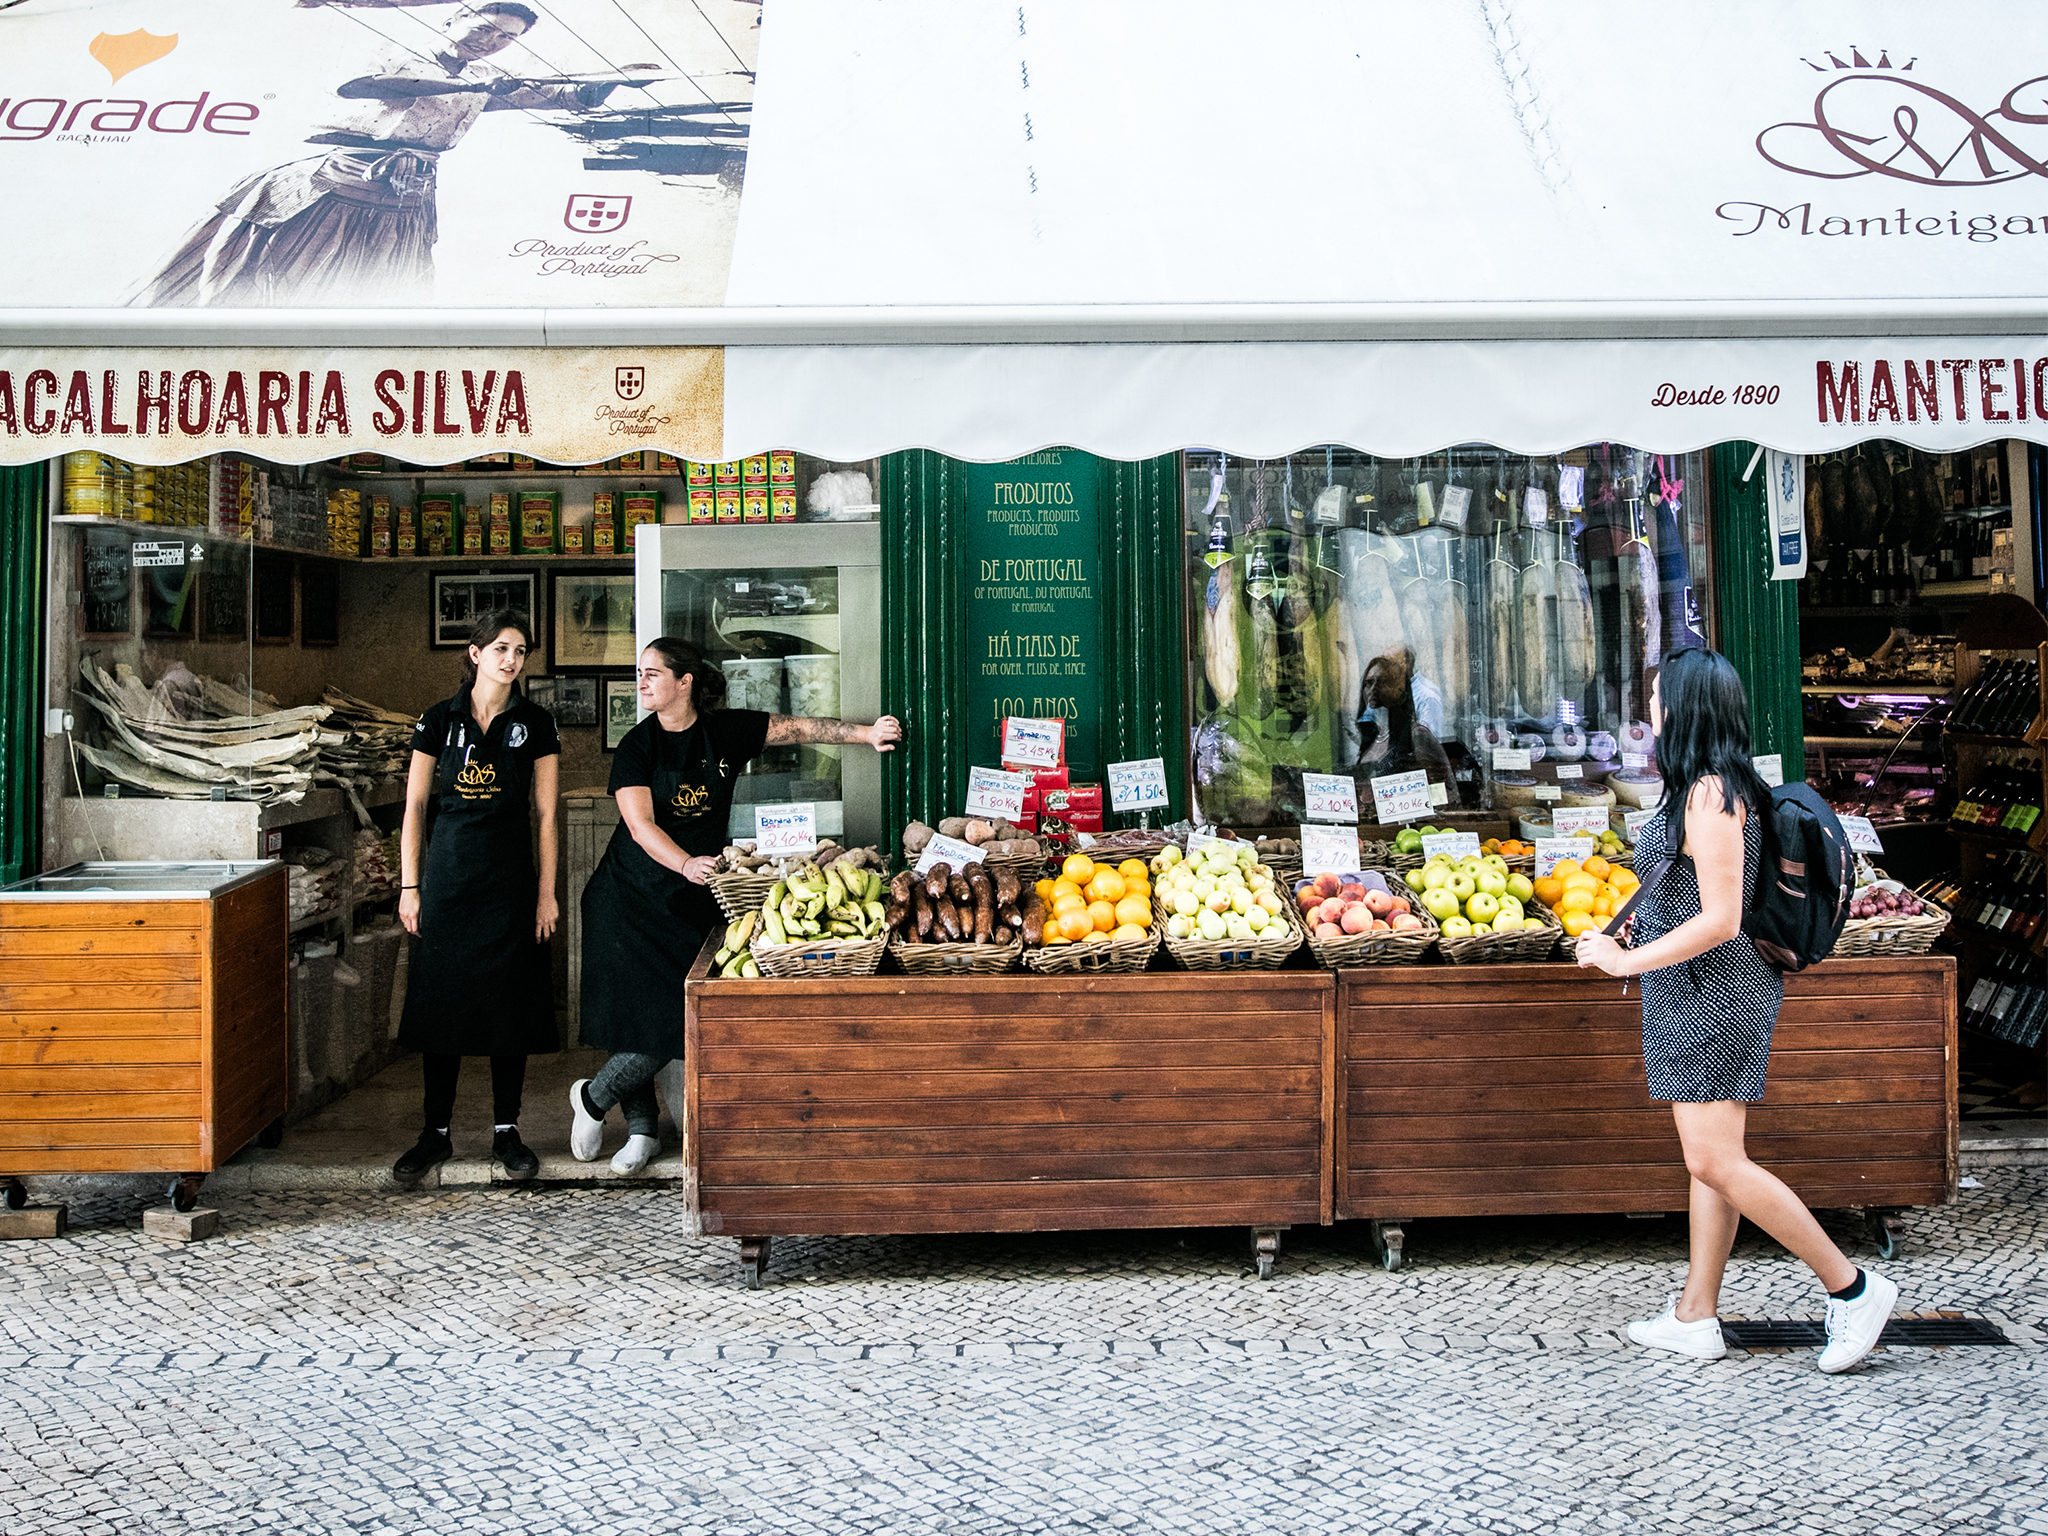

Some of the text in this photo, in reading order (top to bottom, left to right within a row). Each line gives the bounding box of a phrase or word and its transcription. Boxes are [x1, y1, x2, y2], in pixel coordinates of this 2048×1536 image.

[56, 134, 131, 143] BACALHAU
[508, 239, 648, 261] Product of
[537, 254, 680, 278] Portugal
[373, 368, 532, 438] SILVA
[1651, 382, 1781, 407] Desde 1890
[594, 405, 655, 422] Product of
[609, 416, 671, 438] Portugal
[994, 482, 1074, 505] PRODUTOS
[1037, 510, 1080, 522] PRODUITS
[1008, 524, 1059, 536] PRODUCTOS
[981, 559, 1087, 581] DE PORTUGAL
[974, 587, 985, 599] OF
[1036, 587, 1047, 598] DU
[1050, 586, 1093, 599] PORTUGAL
[1012, 603, 1055, 612] DE PORTUGAL
[988, 630, 1081, 657] HÁ MAIS DE
[981, 663, 998, 675] FOR
[1027, 663, 1047, 675] PLUS
[1065, 663, 1086, 675] HACE
[993, 697, 1078, 719] 100 ANOS
[761, 817, 792, 827] Banana
